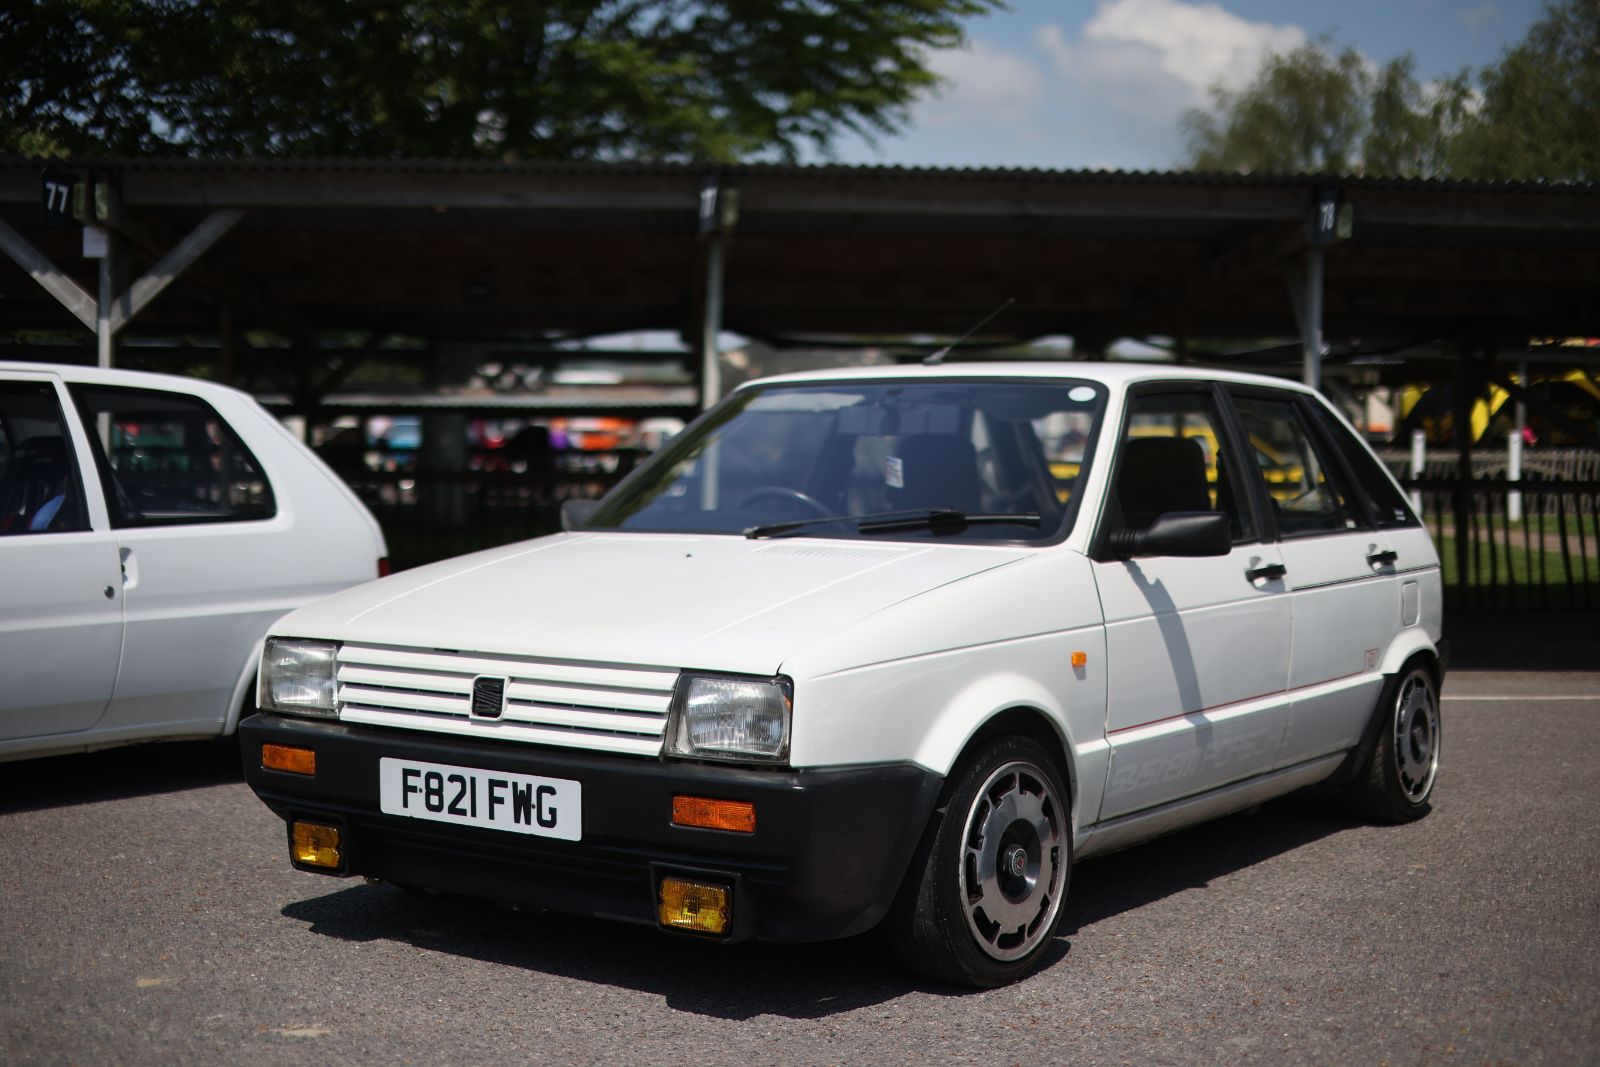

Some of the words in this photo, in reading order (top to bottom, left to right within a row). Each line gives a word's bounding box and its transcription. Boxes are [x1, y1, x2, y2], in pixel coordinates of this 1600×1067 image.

[46, 182, 68, 213] 77
[402, 767, 477, 818] F821
[488, 778, 558, 829] FWG
